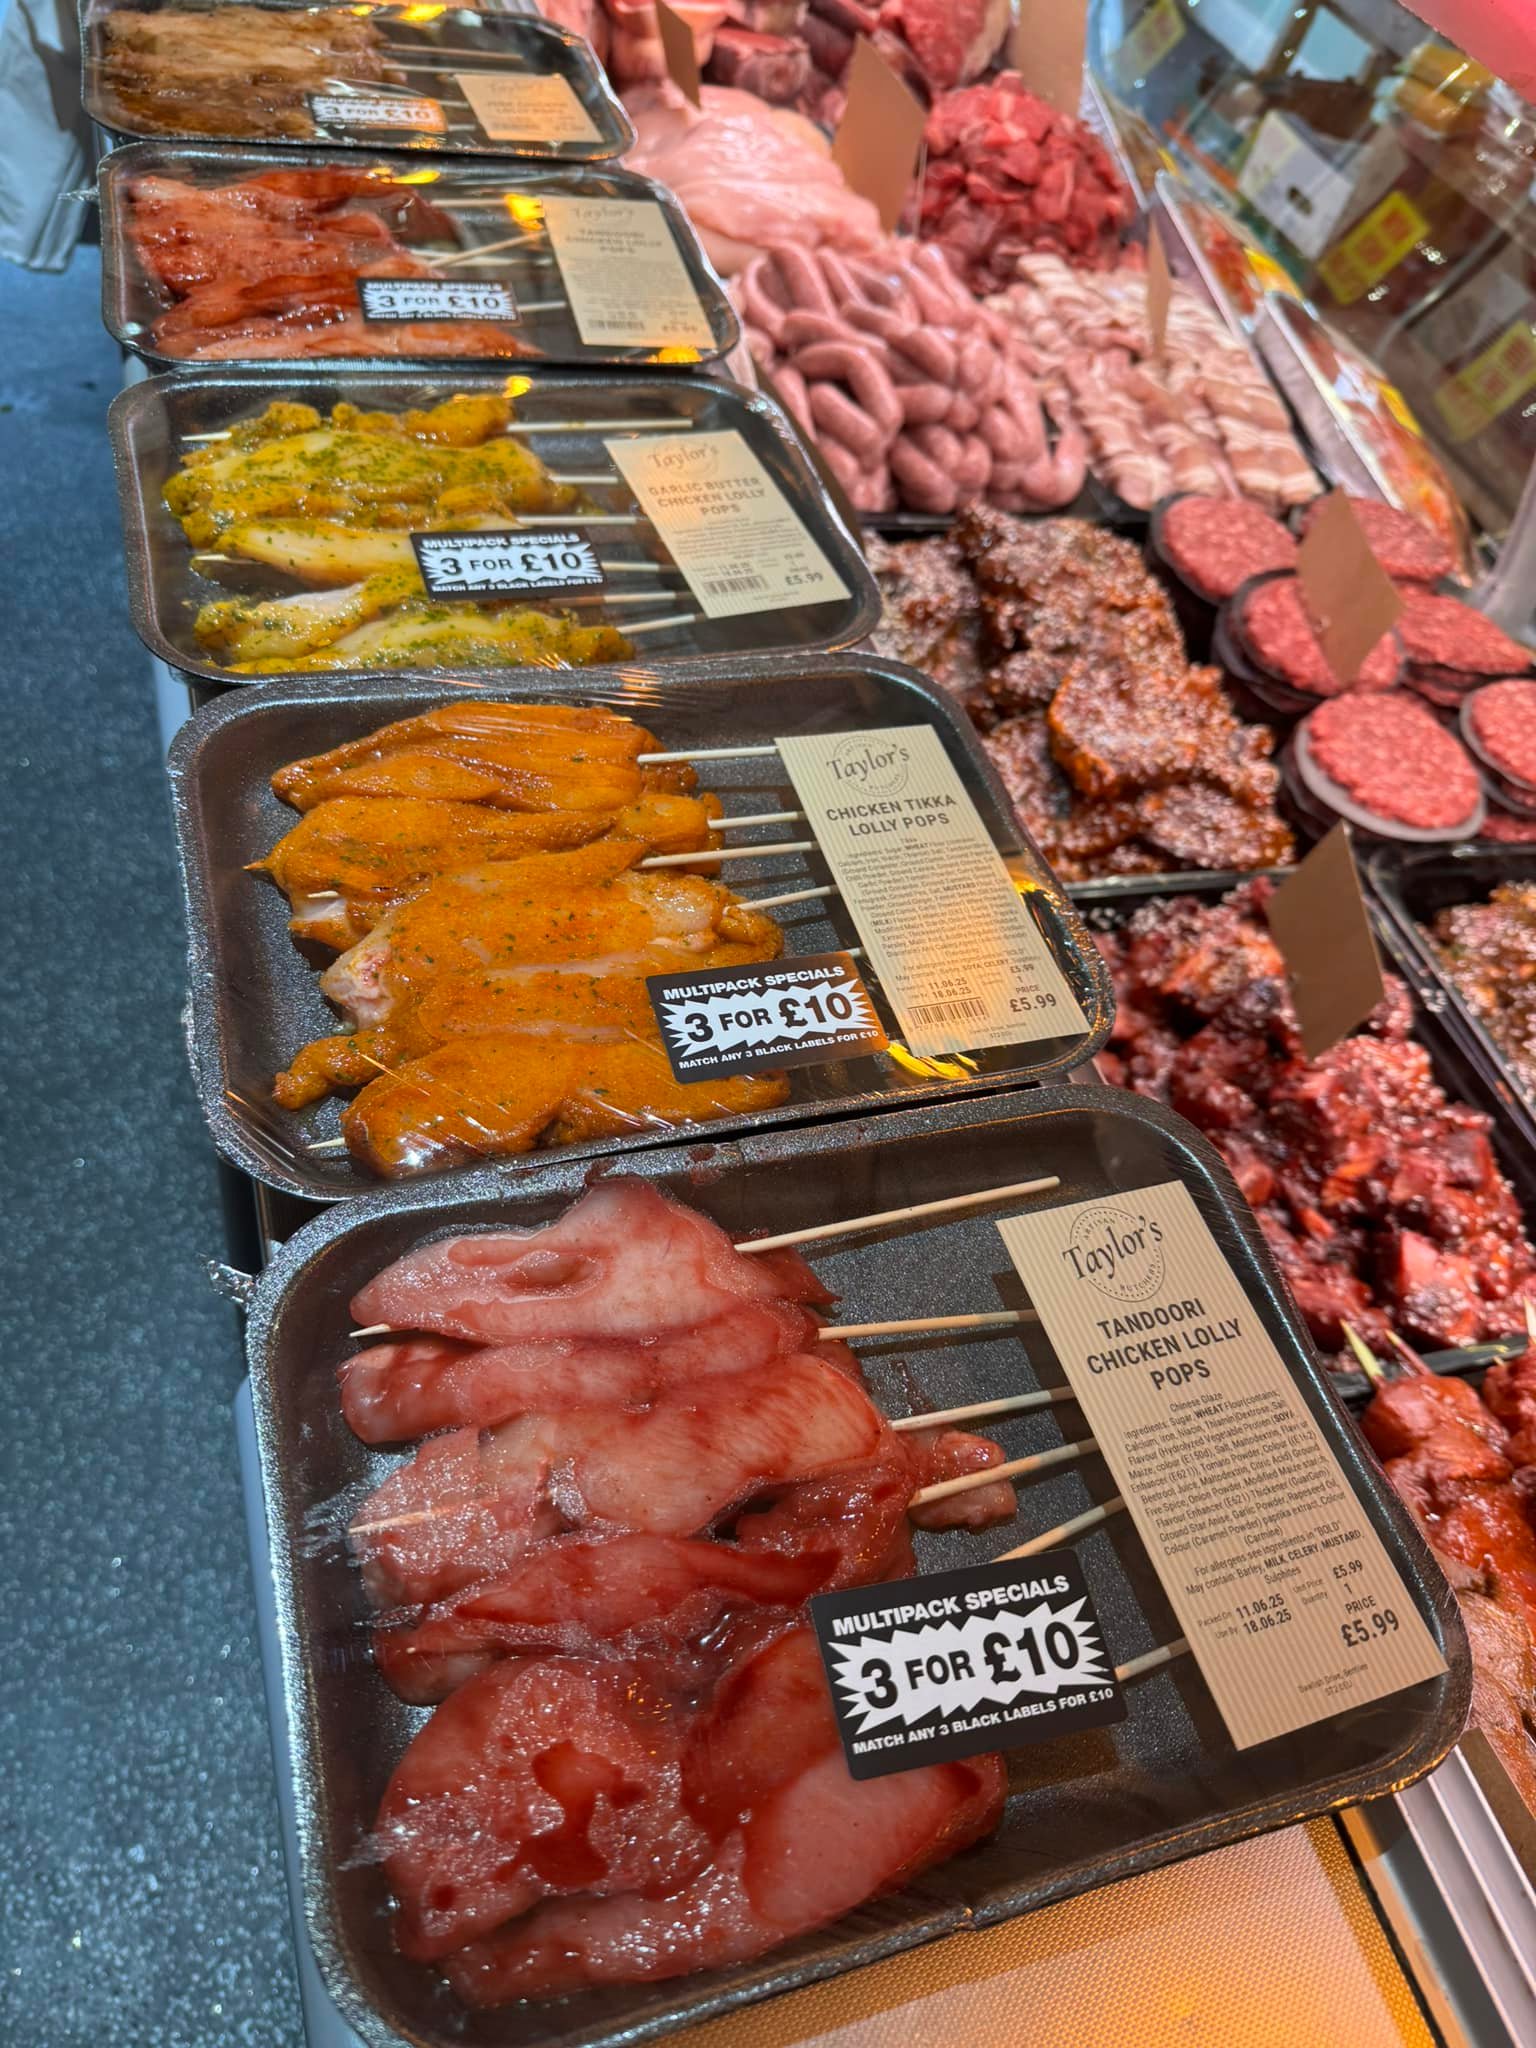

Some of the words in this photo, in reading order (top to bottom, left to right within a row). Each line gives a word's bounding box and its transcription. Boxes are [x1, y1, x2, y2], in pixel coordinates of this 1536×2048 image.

[380, 296, 396, 307] 3
[448, 296, 500, 308] £10
[649, 443, 719, 468] Taylor's
[658, 494, 722, 507] CHICKEN
[724, 488, 764, 500] LOLLY
[700, 504, 740, 515] POPS
[423, 538, 507, 548] MULTIPACK
[510, 534, 579, 545] SPECIALS
[441, 558, 462, 575] 3
[469, 559, 512, 570] FOR
[521, 552, 581, 572] £10
[785, 572, 823, 586] £5.99
[825, 743, 910, 781] Taylor's
[826, 801, 902, 821] CHICKEN
[904, 795, 956, 810] TIKKA
[848, 819, 897, 836] LOLLY
[902, 813, 949, 829] POPS
[1010, 964, 1034, 973] £5.99
[663, 978, 762, 1000] MULTIPACK
[765, 966, 845, 985] SPECIALS
[928, 977, 967, 990] 11.06.25
[932, 986, 972, 999] 18.06.25
[1015, 984, 1040, 994] PRICE
[1010, 993, 1056, 1012] £5.99
[685, 1013, 714, 1042] 3
[718, 1008, 772, 1031] FOR
[778, 992, 852, 1028] £10
[679, 1056, 718, 1069] MATCH
[721, 1052, 742, 1062] ANY
[745, 1050, 753, 1058] 3
[755, 1044, 792, 1056] BLACK
[794, 1037, 835, 1049] LABELS
[836, 1033, 858, 1042] FOR
[860, 1030, 879, 1038] £10
[1060, 1215, 1163, 1279] Taylor's
[1097, 1298, 1205, 1339] TANDOORI
[1087, 1335, 1181, 1374] CHICKEN
[1182, 1318, 1241, 1349] LOLLY
[1150, 1359, 1210, 1390] POPS
[1170, 1399, 1201, 1412] Chinese
[1200, 1392, 1223, 1404] Glaze
[1194, 1404, 1224, 1419] WHEAT
[1128, 1451, 1158, 1466] Flavour
[1203, 1426, 1243, 1443] Vegetable
[1250, 1459, 1272, 1471] Citric
[1292, 1442, 1320, 1458] Ground
[1130, 1477, 1168, 1493] Enhancer
[1200, 1458, 1231, 1472] Tomato
[1230, 1448, 1264, 1463] Powder,
[1262, 1440, 1288, 1454] Colour
[1156, 1459, 1180, 1472] colour
[1144, 1507, 1163, 1517] Five
[1162, 1500, 1190, 1512] Spice,
[1188, 1492, 1212, 1504] Onion
[1211, 1482, 1245, 1496] Powder,
[1243, 1469, 1278, 1487] Modified
[1278, 1464, 1302, 1476] Maize
[1155, 1513, 1186, 1528] Flavour
[1186, 1502, 1223, 1519] Enhancer
[1250, 1482, 1288, 1498] Thickener
[1159, 1525, 1190, 1542] Ground
[1188, 1521, 1207, 1533] Star
[1232, 1506, 1256, 1519] Garlic
[1287, 1482, 1326, 1500] Rapeseed
[1164, 1541, 1191, 1556] Colour
[1192, 1527, 1229, 1549] (Caramel
[1228, 1517, 1262, 1534] Powder)
[1262, 1510, 1292, 1526] paprika
[1320, 1491, 1346, 1505] Colour
[1244, 1524, 1283, 1547] (Carmine)
[1186, 1584, 1204, 1594] May
[1288, 1544, 1322, 1561] CELERY,
[1321, 1530, 1364, 1548] MUSTARD,
[1194, 1566, 1209, 1576] For
[1210, 1554, 1247, 1572] allergens
[1247, 1548, 1262, 1559] see
[1262, 1534, 1306, 1554] ingredients
[1305, 1531, 1315, 1540] in
[1264, 1566, 1302, 1585] Sulphites
[1333, 1560, 1363, 1579] £5.99
[1344, 1583, 1352, 1594] 1
[833, 1596, 961, 1636] MULTIPACK
[965, 1576, 1069, 1610] SPECIALS
[1236, 1593, 1284, 1619] 11.06.25
[1345, 1595, 1376, 1614] PRICE
[1243, 1608, 1292, 1634] 18.06.25
[1341, 1609, 1399, 1647] £5.99
[861, 1658, 898, 1709] 3
[905, 1650, 975, 1690] FOR
[983, 1622, 1079, 1684] £10
[853, 1734, 904, 1754] MATCH
[908, 1726, 935, 1742] ANY
[939, 1724, 949, 1735] 3
[952, 1712, 1001, 1732] BLACK
[1004, 1700, 1056, 1721] LABELS
[1059, 1694, 1087, 1709] FOR
[1089, 1688, 1113, 1702] £10
